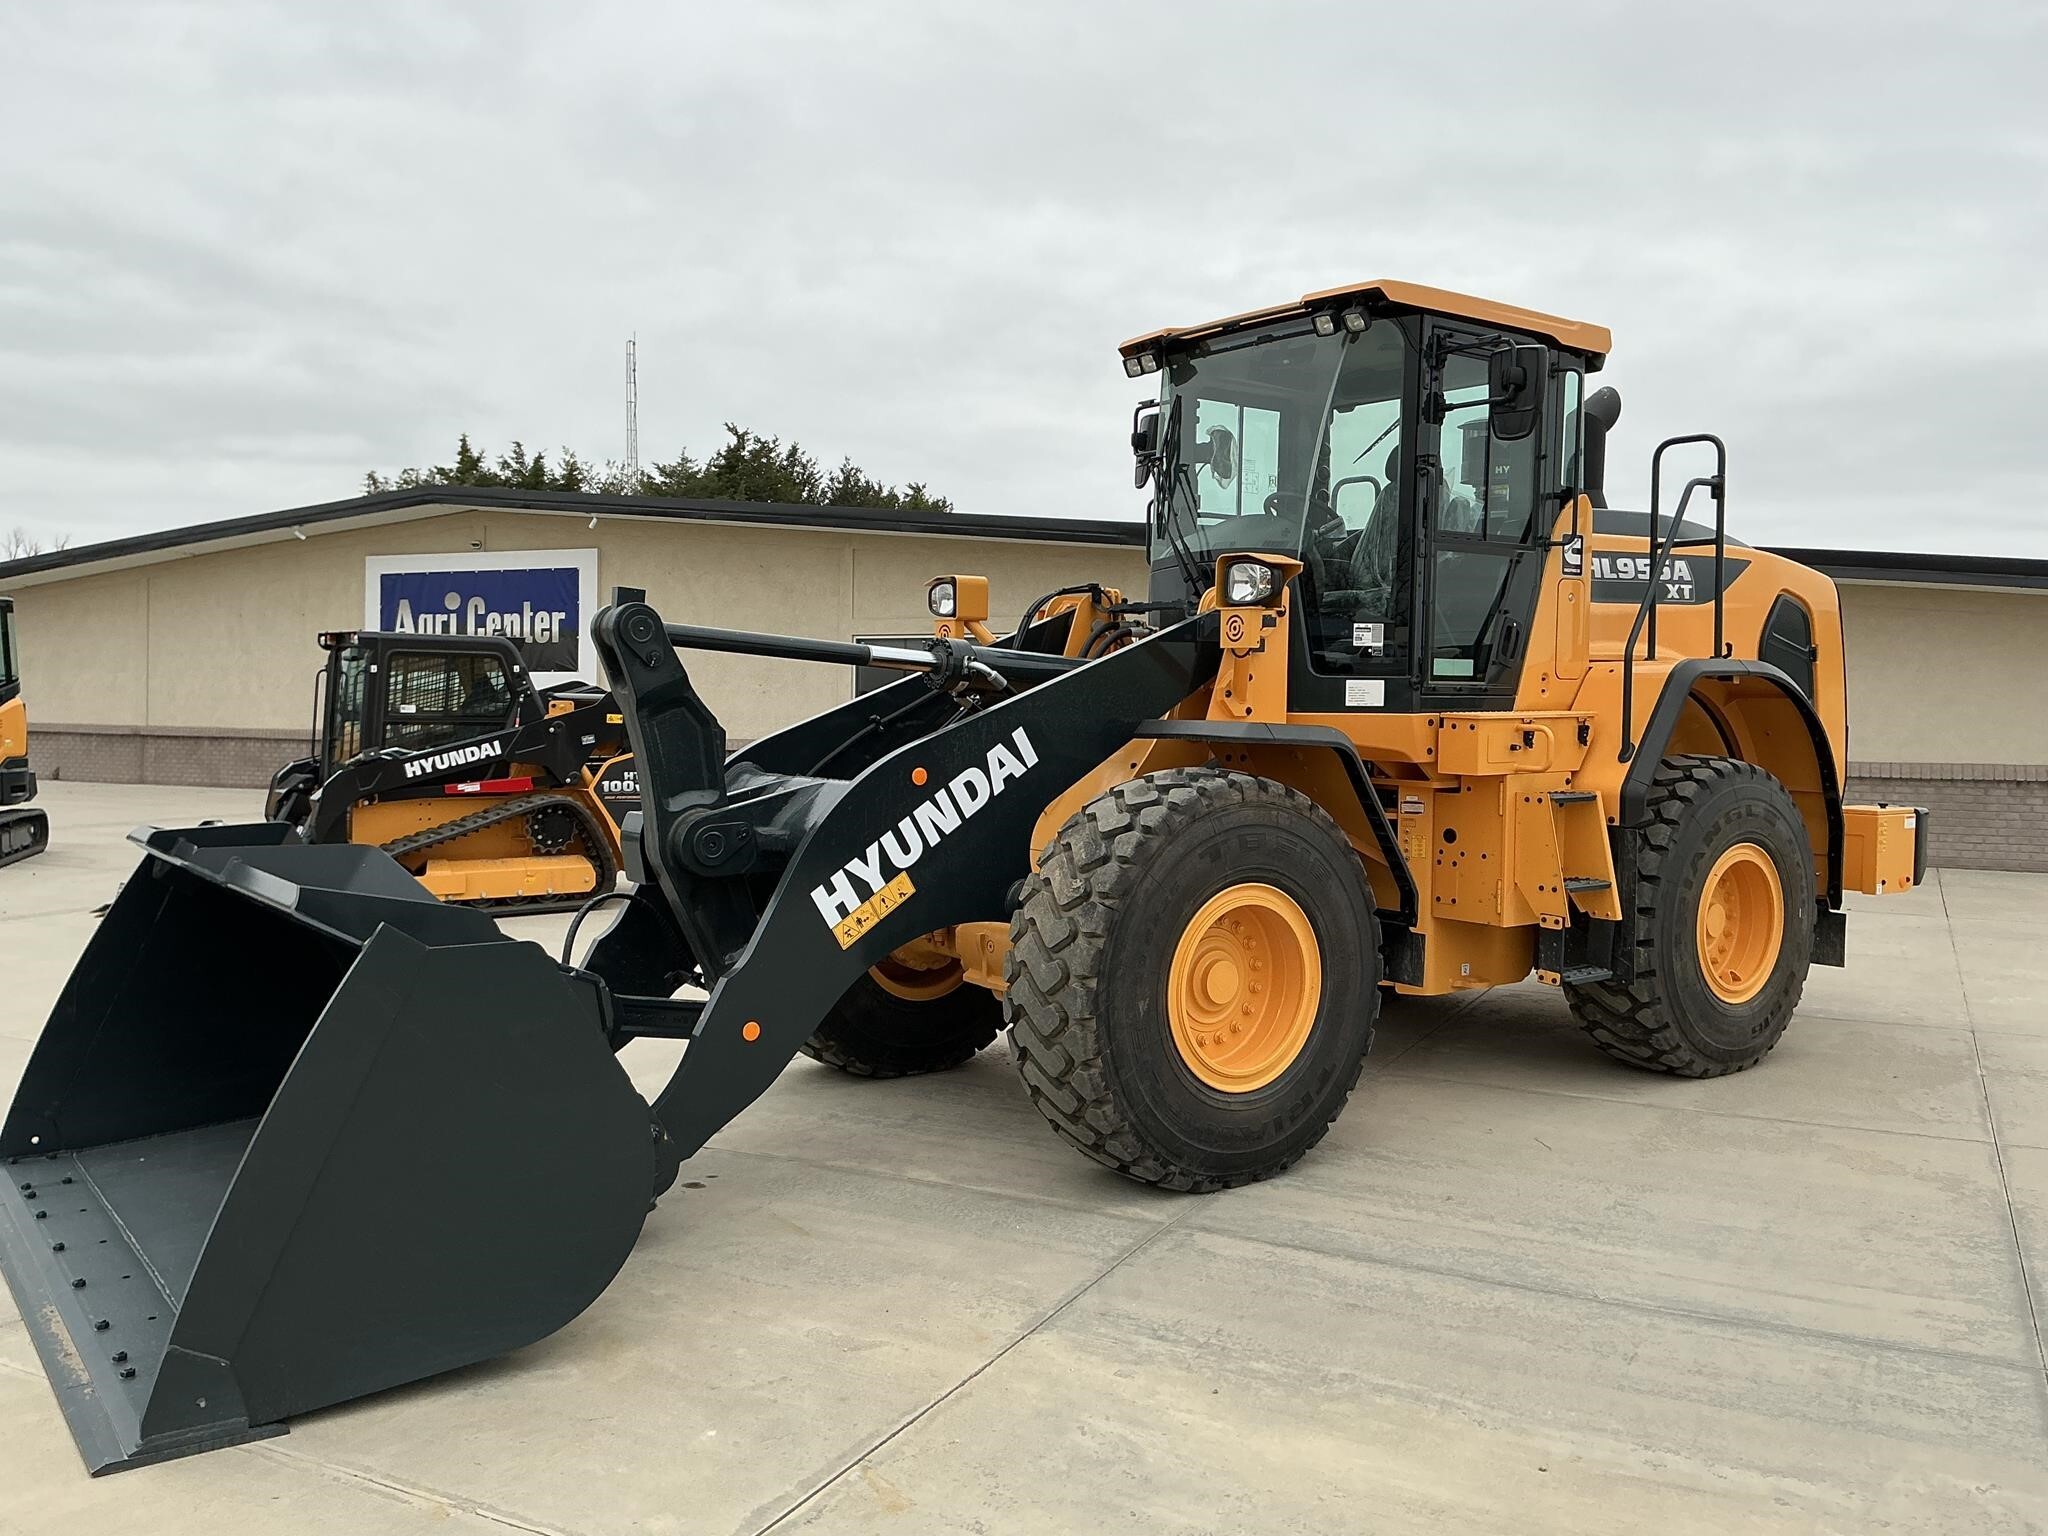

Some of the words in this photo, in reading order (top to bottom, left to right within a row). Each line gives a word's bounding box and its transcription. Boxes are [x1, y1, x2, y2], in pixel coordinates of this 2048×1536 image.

[1665, 583, 1693, 600] XT
[467, 596, 566, 644] Center
[404, 740, 502, 778] HYUNDAI
[810, 725, 1040, 930] HYUNDAI
